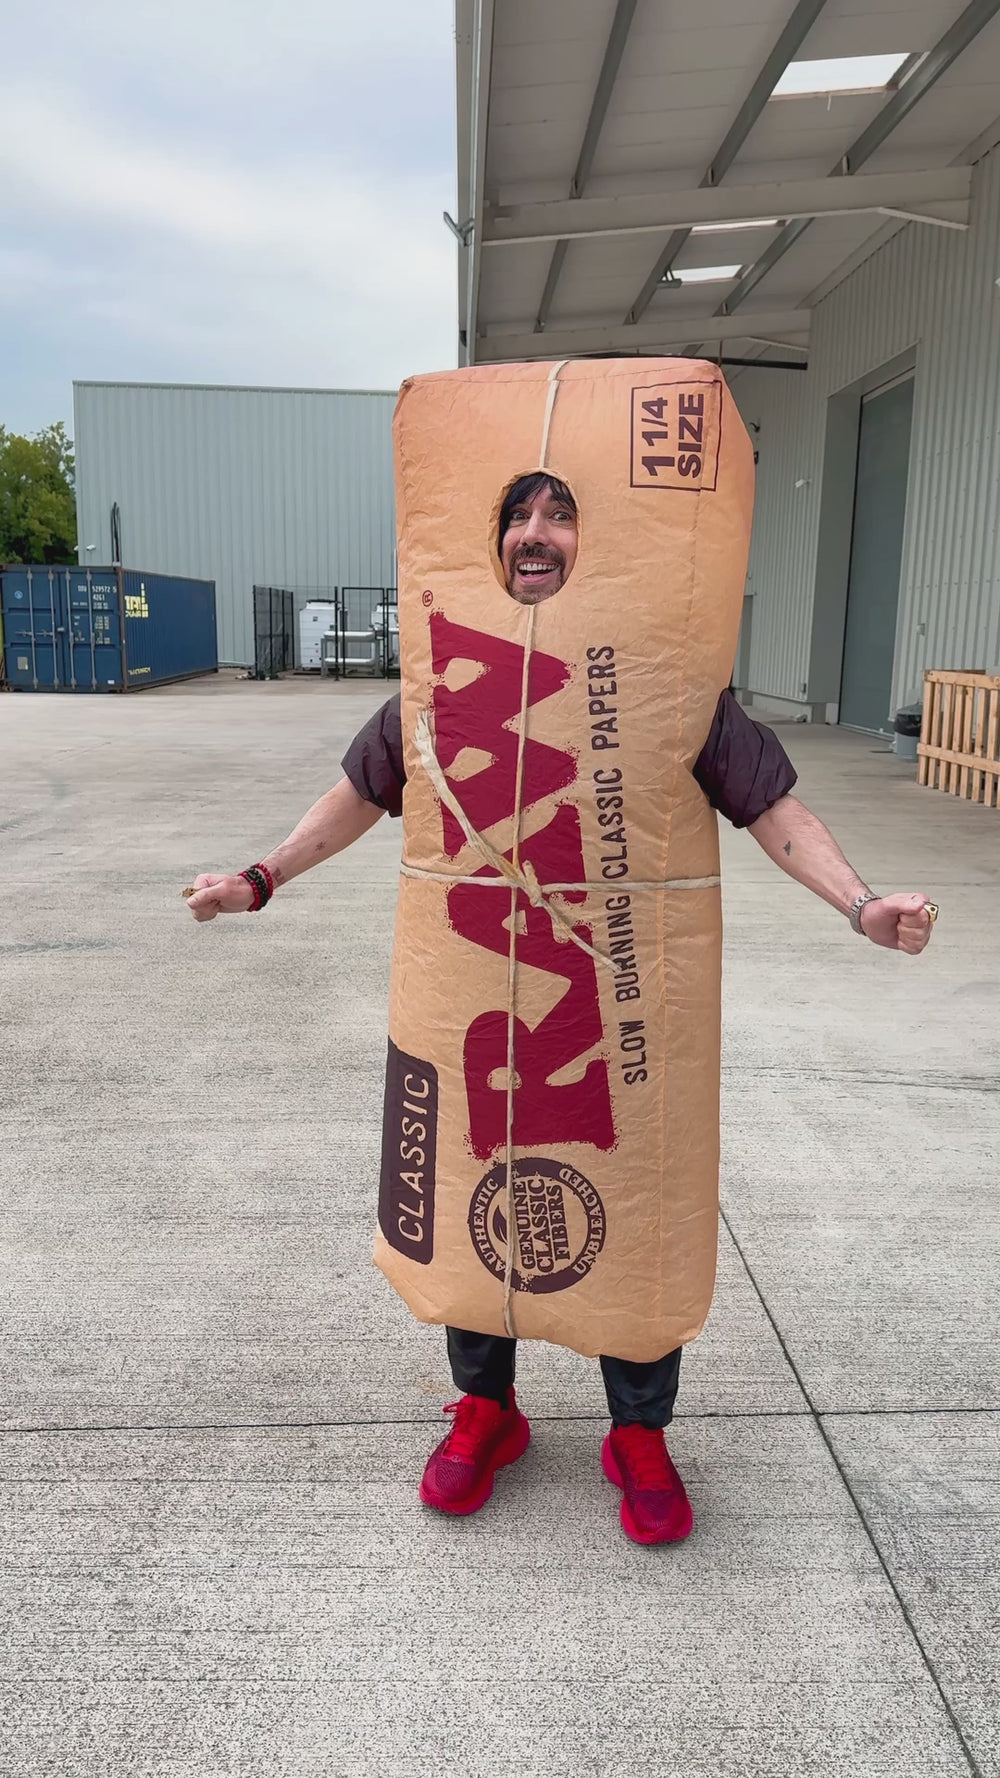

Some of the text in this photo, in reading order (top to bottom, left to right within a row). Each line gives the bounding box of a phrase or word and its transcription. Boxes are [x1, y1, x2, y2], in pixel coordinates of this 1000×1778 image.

[641, 397, 675, 476] 1 1/4
[677, 393, 704, 478] SIZE
[429, 609, 618, 1161] RAW
[586, 645, 648, 1086] SLOW BURNING CLASSIC PAPERS
[398, 1073, 430, 1243] CLASSIC
[473, 1177, 507, 1273] AUTHENTIC
[511, 1180, 537, 1270] GENUINE
[527, 1178, 554, 1273] CLASSIC
[545, 1184, 571, 1261] FIBERS
[558, 1167, 603, 1274] UNBLEACHED
